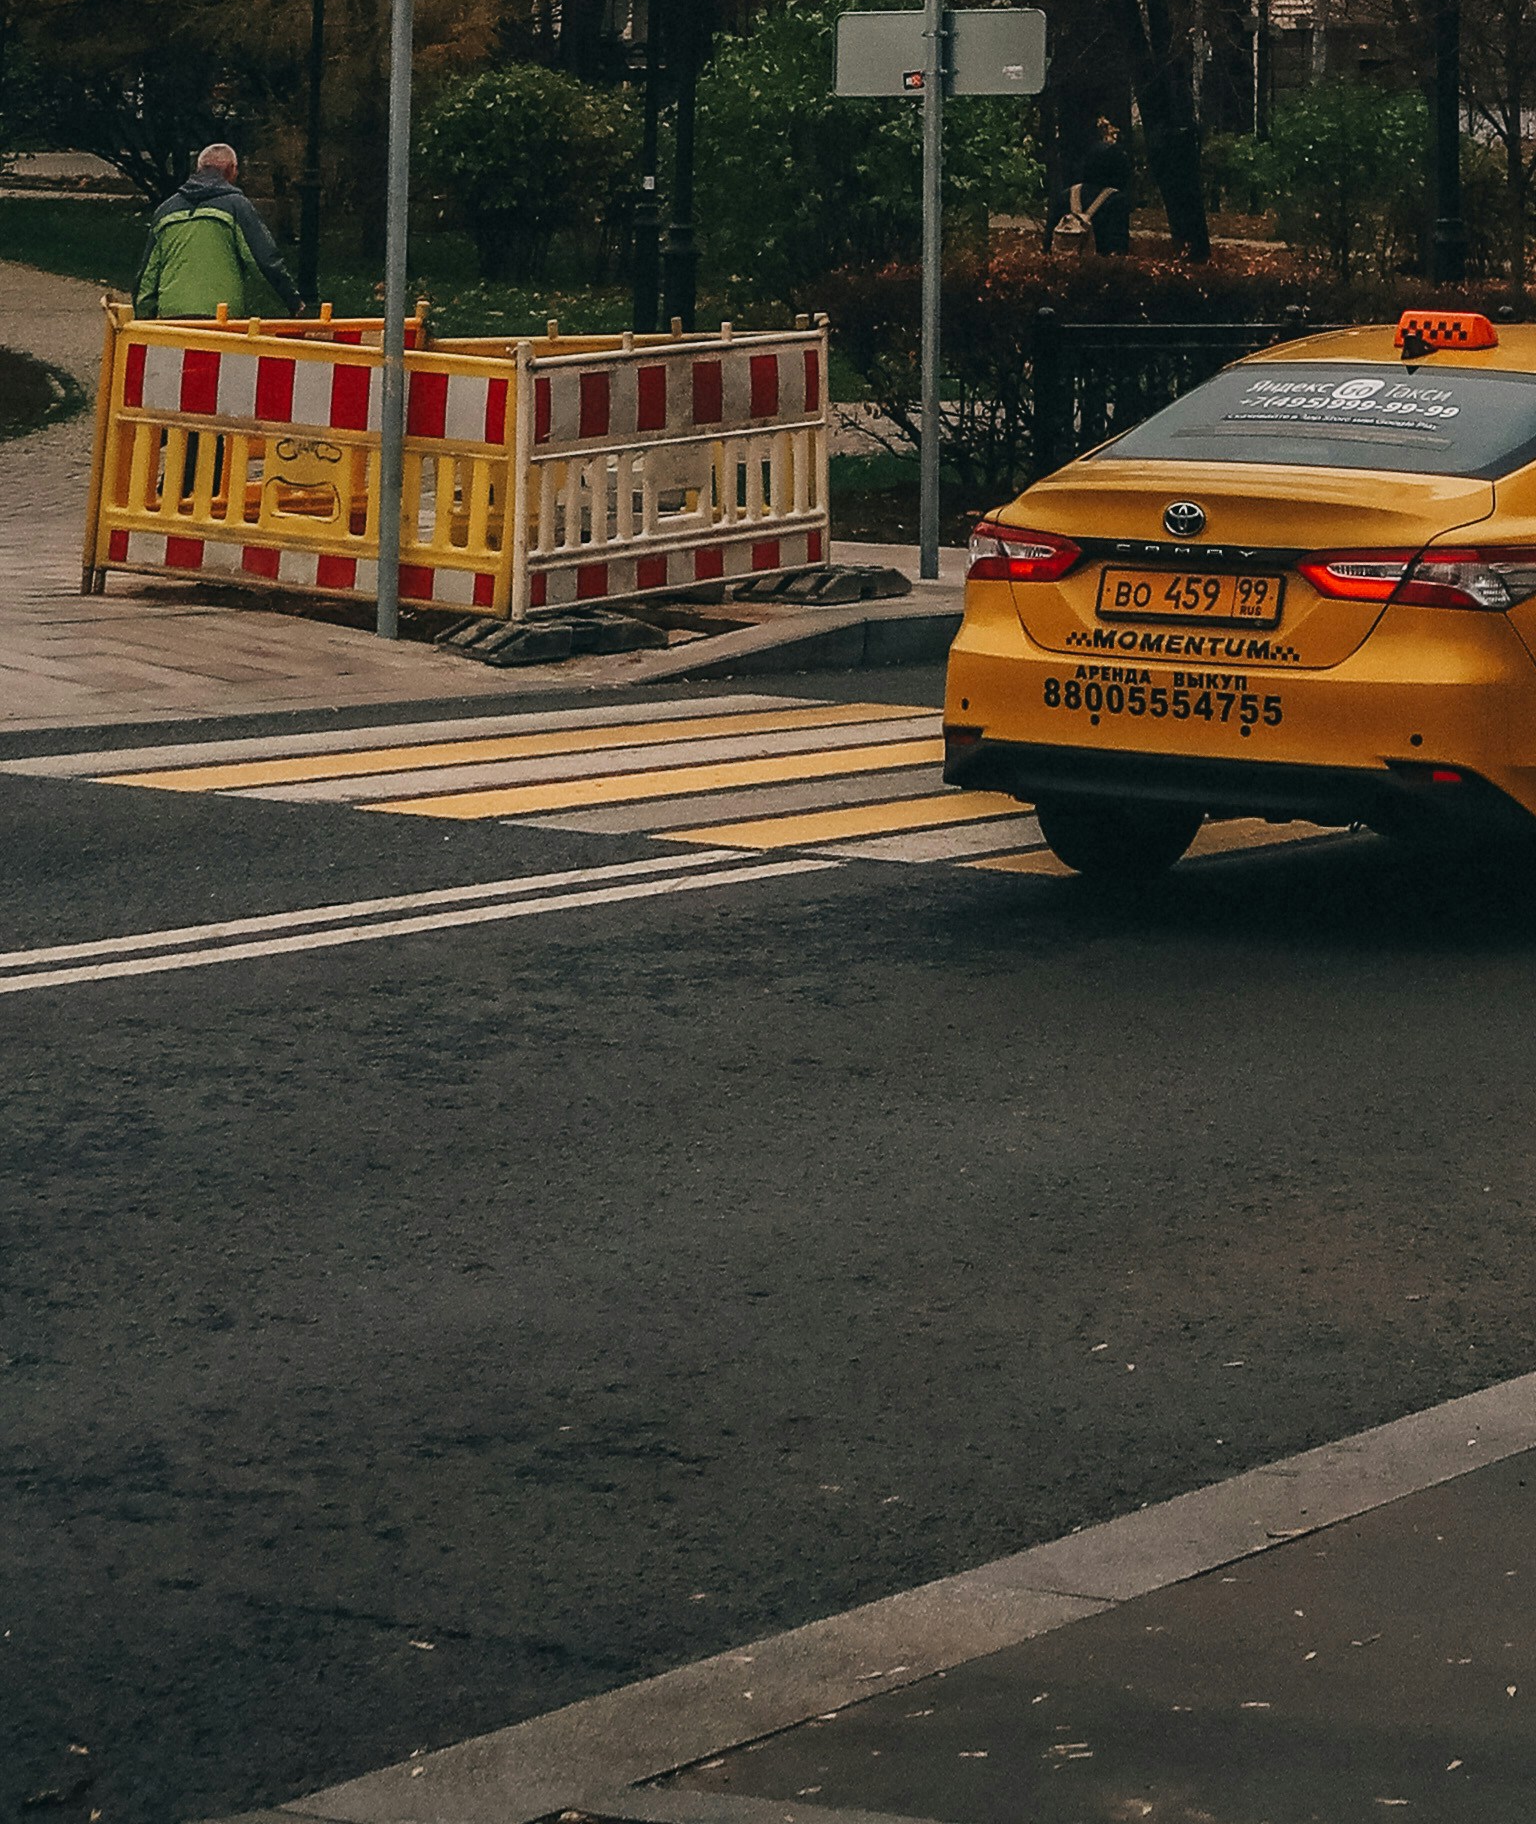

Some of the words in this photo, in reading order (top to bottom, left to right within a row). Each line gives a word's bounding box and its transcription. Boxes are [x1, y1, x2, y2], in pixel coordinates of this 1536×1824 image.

[1246, 379, 1334, 394] Яндекс
[1384, 383, 1454, 402] Такси
[1239, 395, 1461, 418] +7(495)999-99-99
[1164, 576, 1221, 612] 459
[1238, 578, 1269, 605] 99
[1239, 605, 1262, 616] RUS
[1093, 628, 1271, 661] MOMENTUM
[1075, 664, 1151, 684] АРЕНДА
[1173, 671, 1247, 691] ВЫКУП
[1044, 678, 1282, 726] 88005554755
